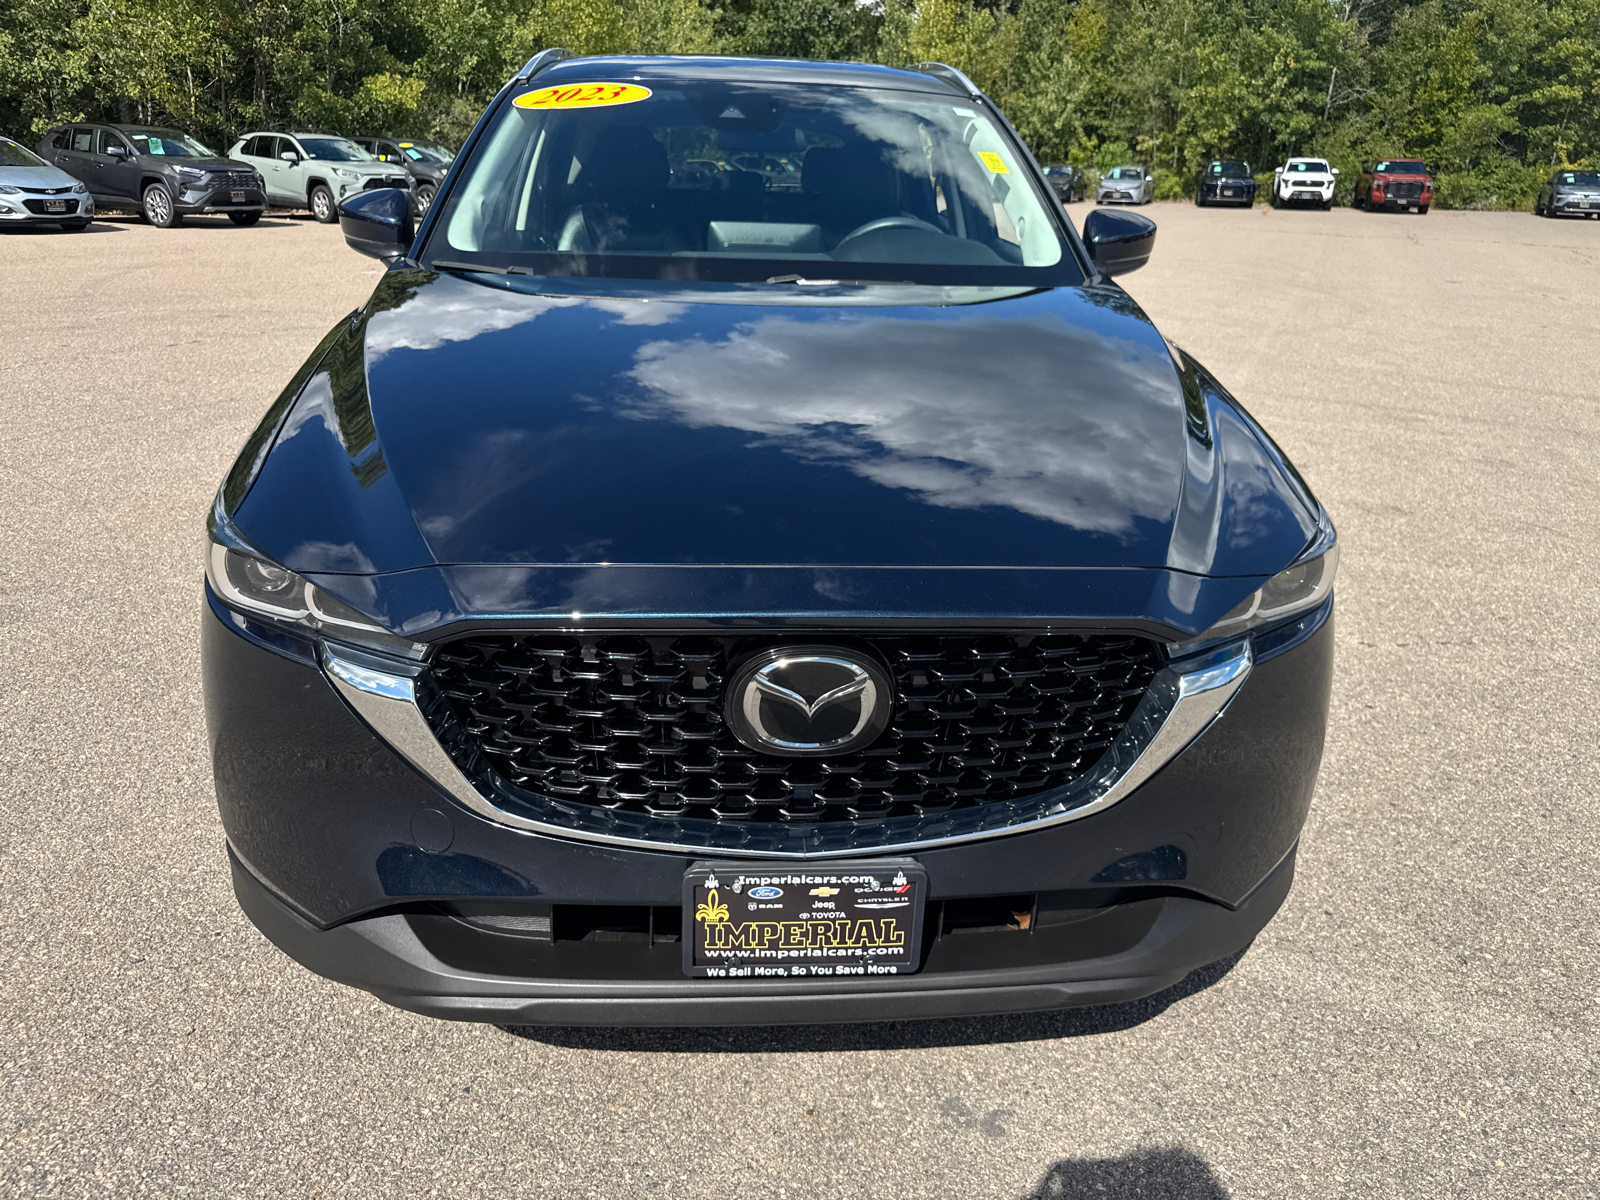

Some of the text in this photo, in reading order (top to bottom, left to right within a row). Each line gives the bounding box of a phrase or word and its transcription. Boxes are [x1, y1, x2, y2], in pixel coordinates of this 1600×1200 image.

[530, 86, 628, 105] 2023
[738, 875, 874, 886] Imperialcars.com
[755, 889, 776, 898] Ford
[811, 900, 836, 910] Jeep
[811, 911, 846, 919] TOYOTA
[704, 919, 905, 949] IMPERIAL
[706, 964, 898, 977] We Sell More, So You Save More
